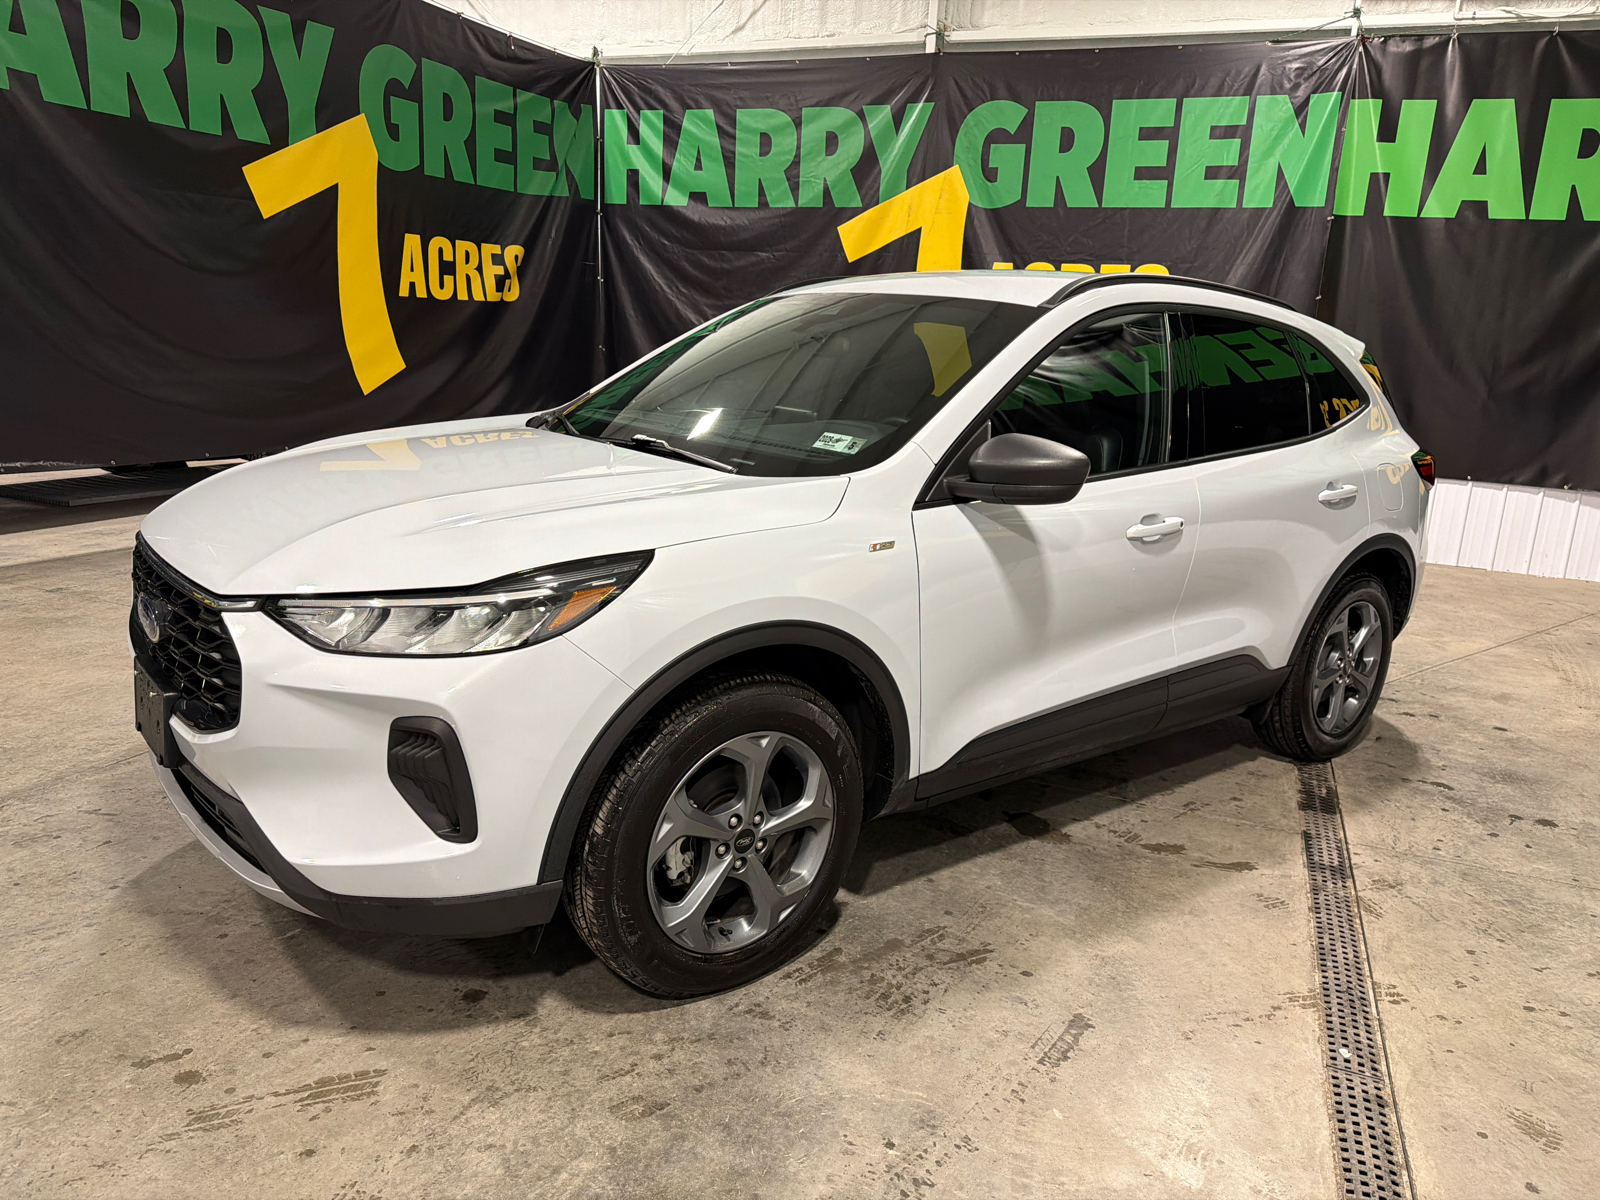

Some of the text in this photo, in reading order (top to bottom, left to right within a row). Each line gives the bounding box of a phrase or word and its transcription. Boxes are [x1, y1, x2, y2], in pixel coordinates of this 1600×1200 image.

[358, 44, 595, 201] GREEN
[604, 92, 1341, 209] HARRY GREEN
[241, 113, 525, 395] 7 ACRES
